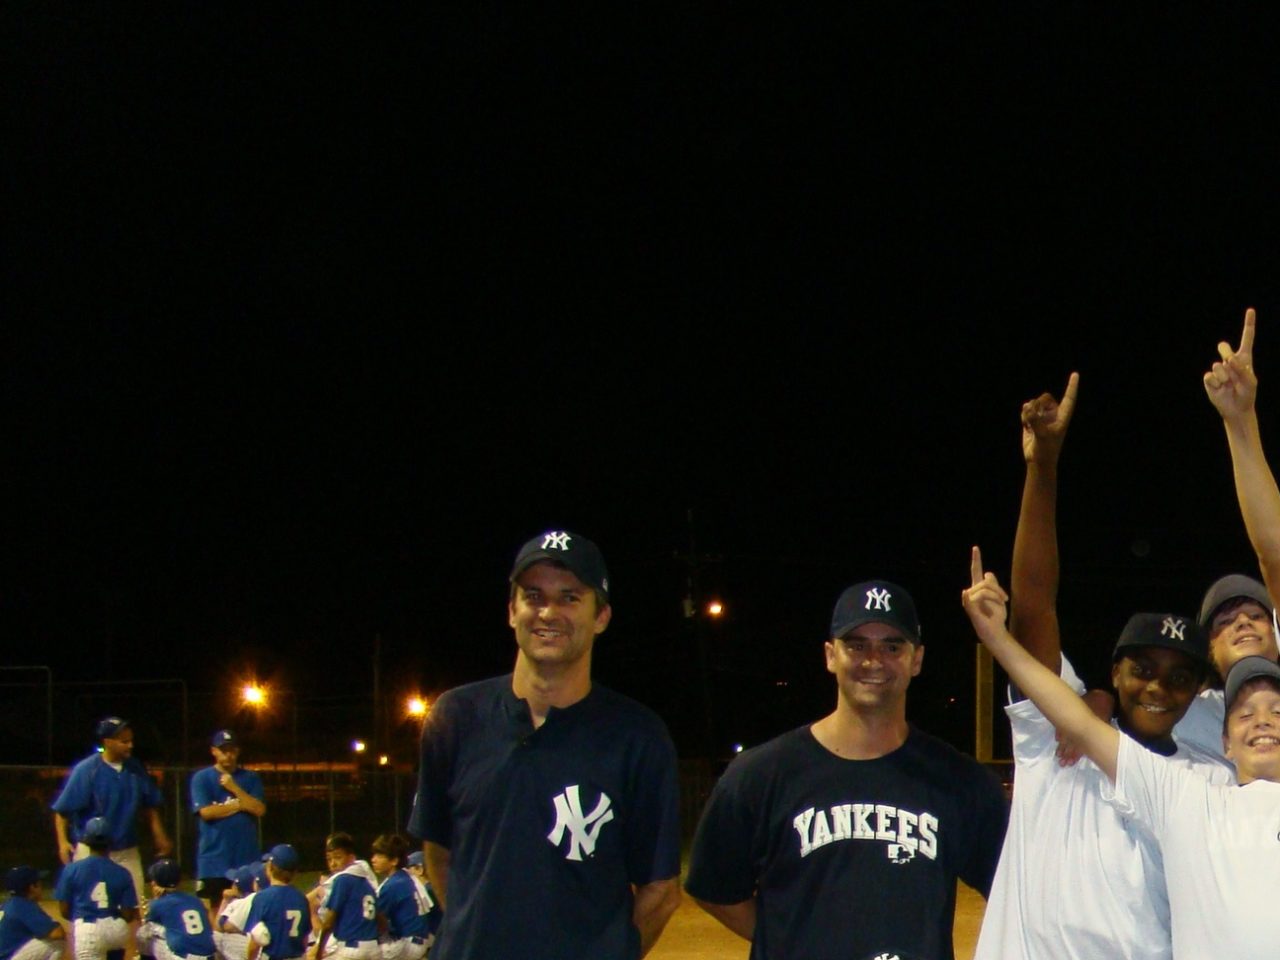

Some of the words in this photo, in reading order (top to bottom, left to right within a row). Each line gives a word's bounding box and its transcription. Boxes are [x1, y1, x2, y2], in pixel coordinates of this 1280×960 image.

[541, 531, 572, 551] NY
[865, 587, 891, 612] NY
[1161, 616, 1186, 641] NY
[547, 784, 614, 861] NY
[793, 803, 939, 861] YANKEES
[90, 881, 109, 909] 4
[182, 909, 204, 935] 8
[286, 910, 302, 937] 7
